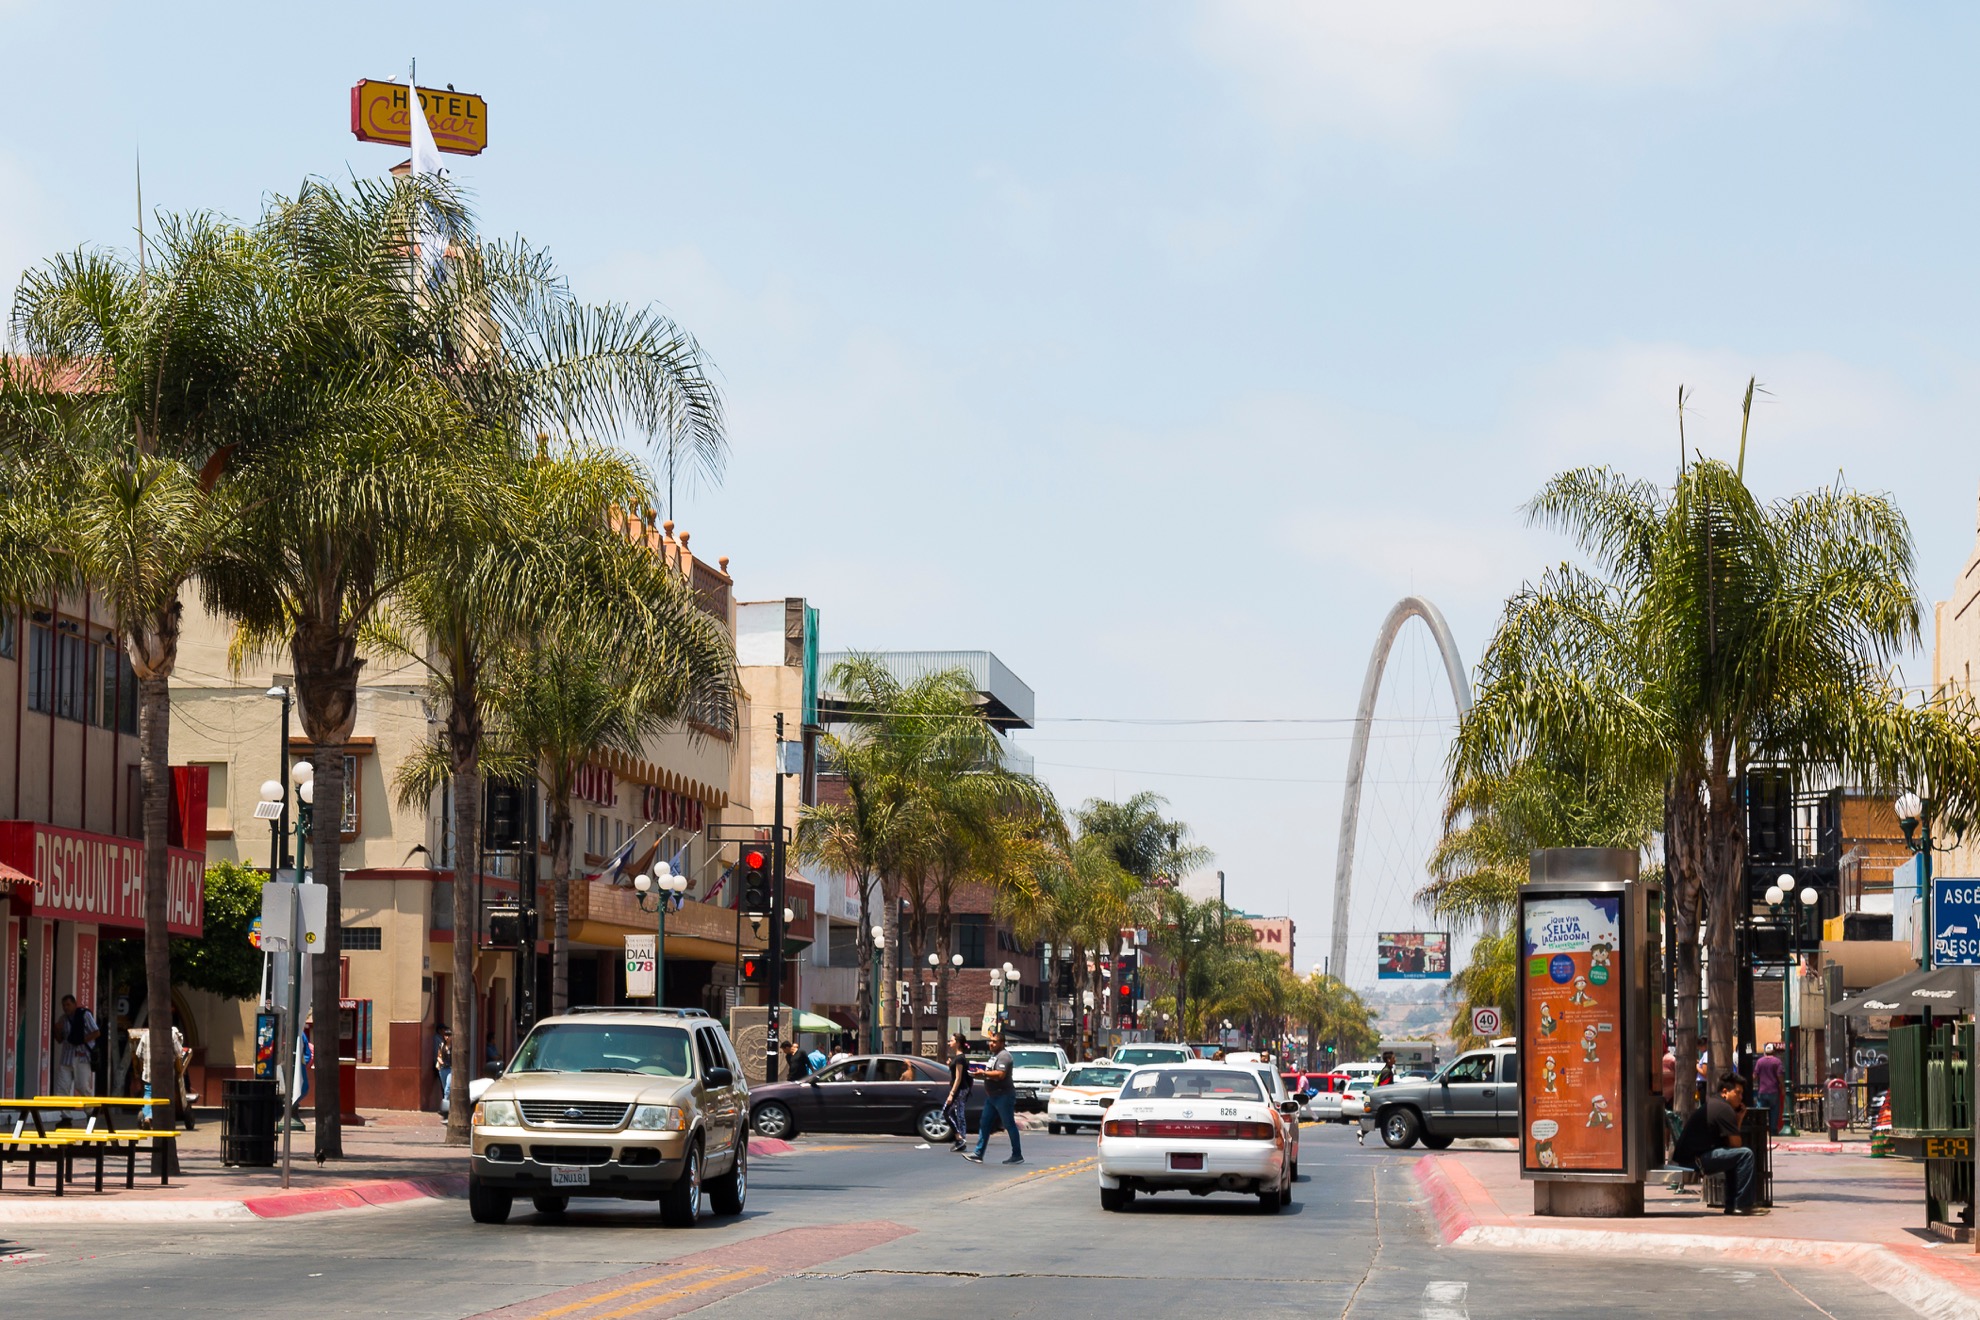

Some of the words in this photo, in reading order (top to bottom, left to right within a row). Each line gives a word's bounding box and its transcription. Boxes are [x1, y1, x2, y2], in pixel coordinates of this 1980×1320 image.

[368, 95, 478, 146] Casar
[34, 832, 119, 916] DISCOUNT
[121, 846, 204, 928] PHMACY
[1546, 922, 1581, 938] SELVA
[626, 949, 654, 960] DIAL
[627, 961, 654, 972] 078
[1479, 1014, 1494, 1025] 40
[1220, 1108, 1237, 1116] 8268
[1927, 1138, 1969, 1159] E-09
